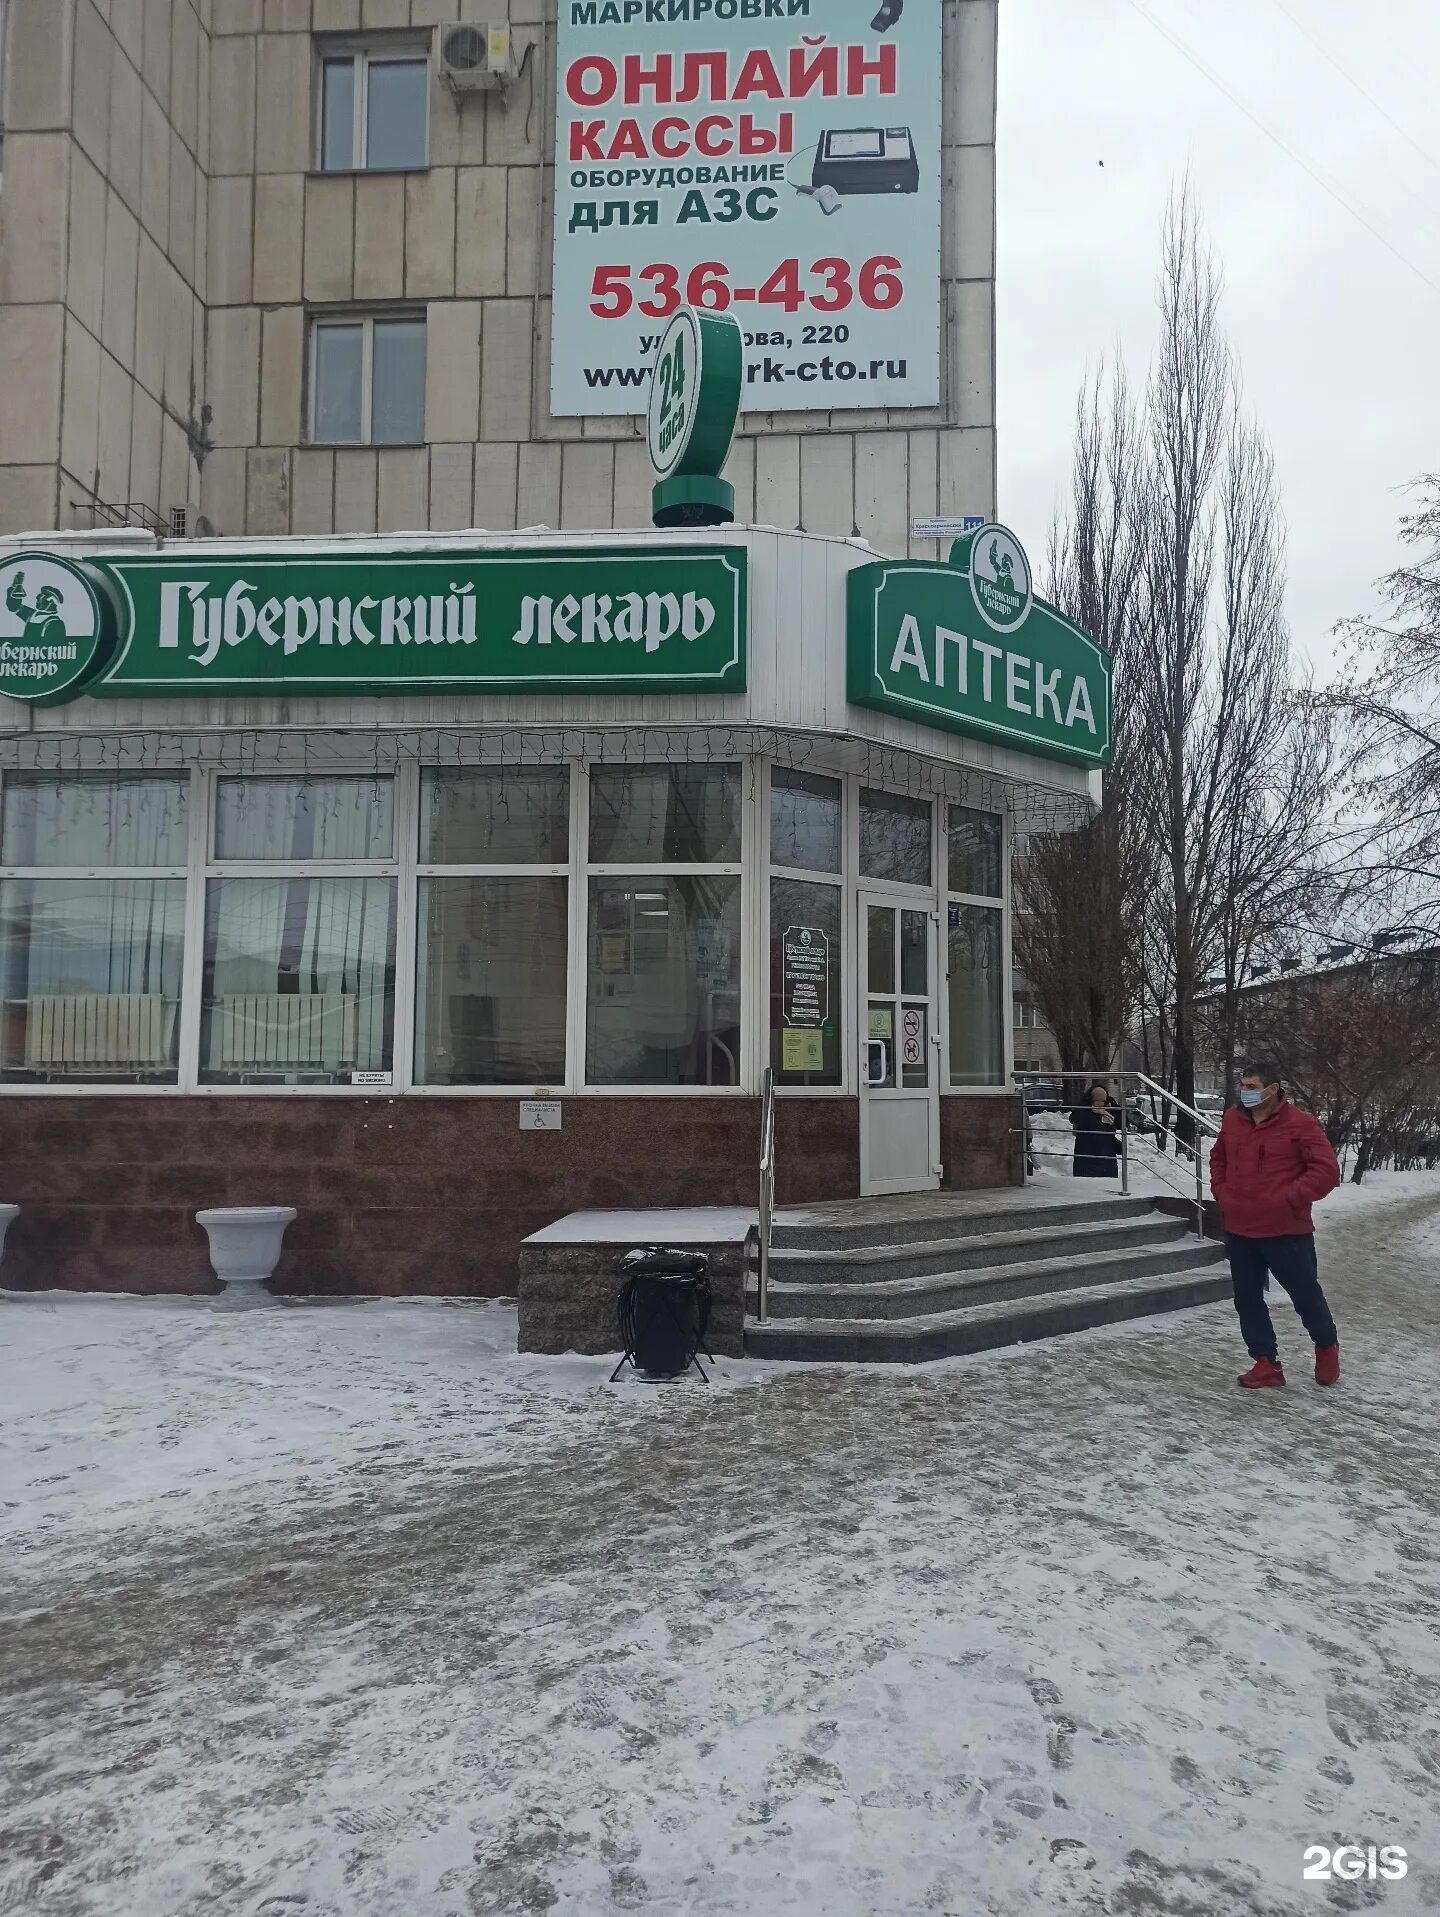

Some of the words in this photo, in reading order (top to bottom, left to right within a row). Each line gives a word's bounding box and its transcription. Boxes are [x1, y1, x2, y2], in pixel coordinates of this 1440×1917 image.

[571, 0, 810, 25] МАРКИРОВКИ
[566, 35, 897, 107] ОНЛАЙН
[569, 113, 793, 161] КАССЫ
[570, 164, 785, 188] ОБОРУДОВАНИЕ
[676, 187, 779, 224] АЗС
[589, 256, 904, 319] 536-436
[801, 325, 850, 344] 220
[659, 331, 685, 416] 24
[659, 402, 684, 454] часа
[159, 580, 478, 666] Губернский
[512, 591, 715, 653] лекарь
[0, 641, 77, 662] бернский
[890, 613, 1097, 734] АПТЕКА
